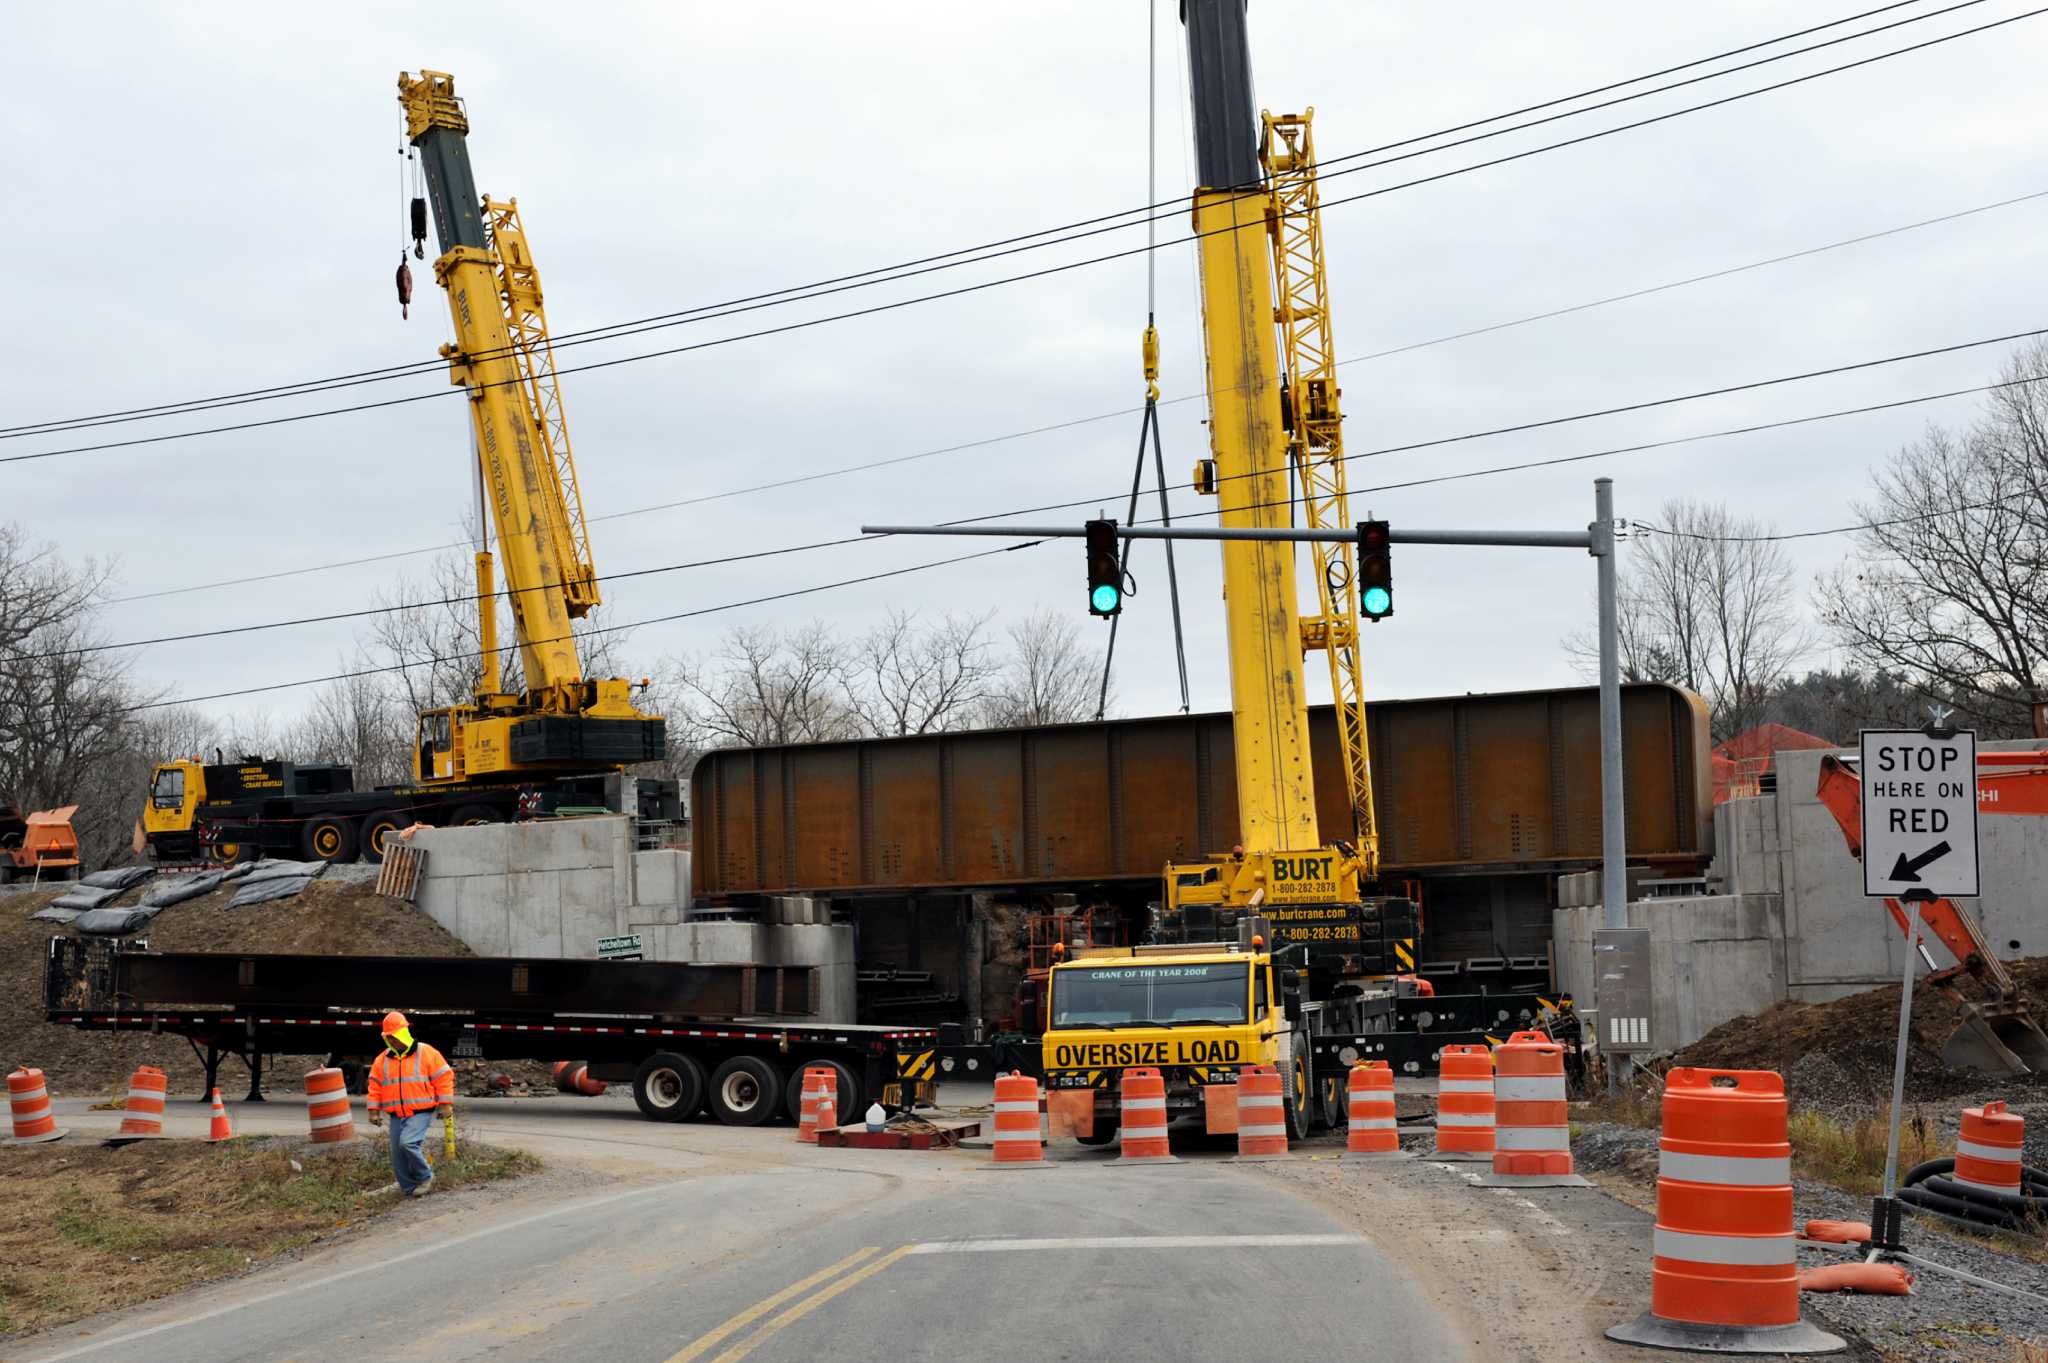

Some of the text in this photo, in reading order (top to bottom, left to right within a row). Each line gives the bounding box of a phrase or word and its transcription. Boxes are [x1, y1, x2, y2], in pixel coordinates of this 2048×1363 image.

[456, 288, 472, 328] BURT
[1878, 746, 1958, 771] STOP
[1874, 782, 1963, 798] HERE ON
[1889, 808, 1949, 832] RED
[1272, 857, 1333, 881] BURT
[1272, 882, 1336, 894] 1-800-282-2878
[1281, 926, 1358, 940] 1-800-282-2878
[1091, 971, 1121, 980] CRANE
[1124, 970, 1137, 978] OF
[1139, 969, 1157, 977] THE
[1159, 969, 1182, 977] YEAR
[1056, 1040, 1240, 1067] OVERSIZE LOAD
